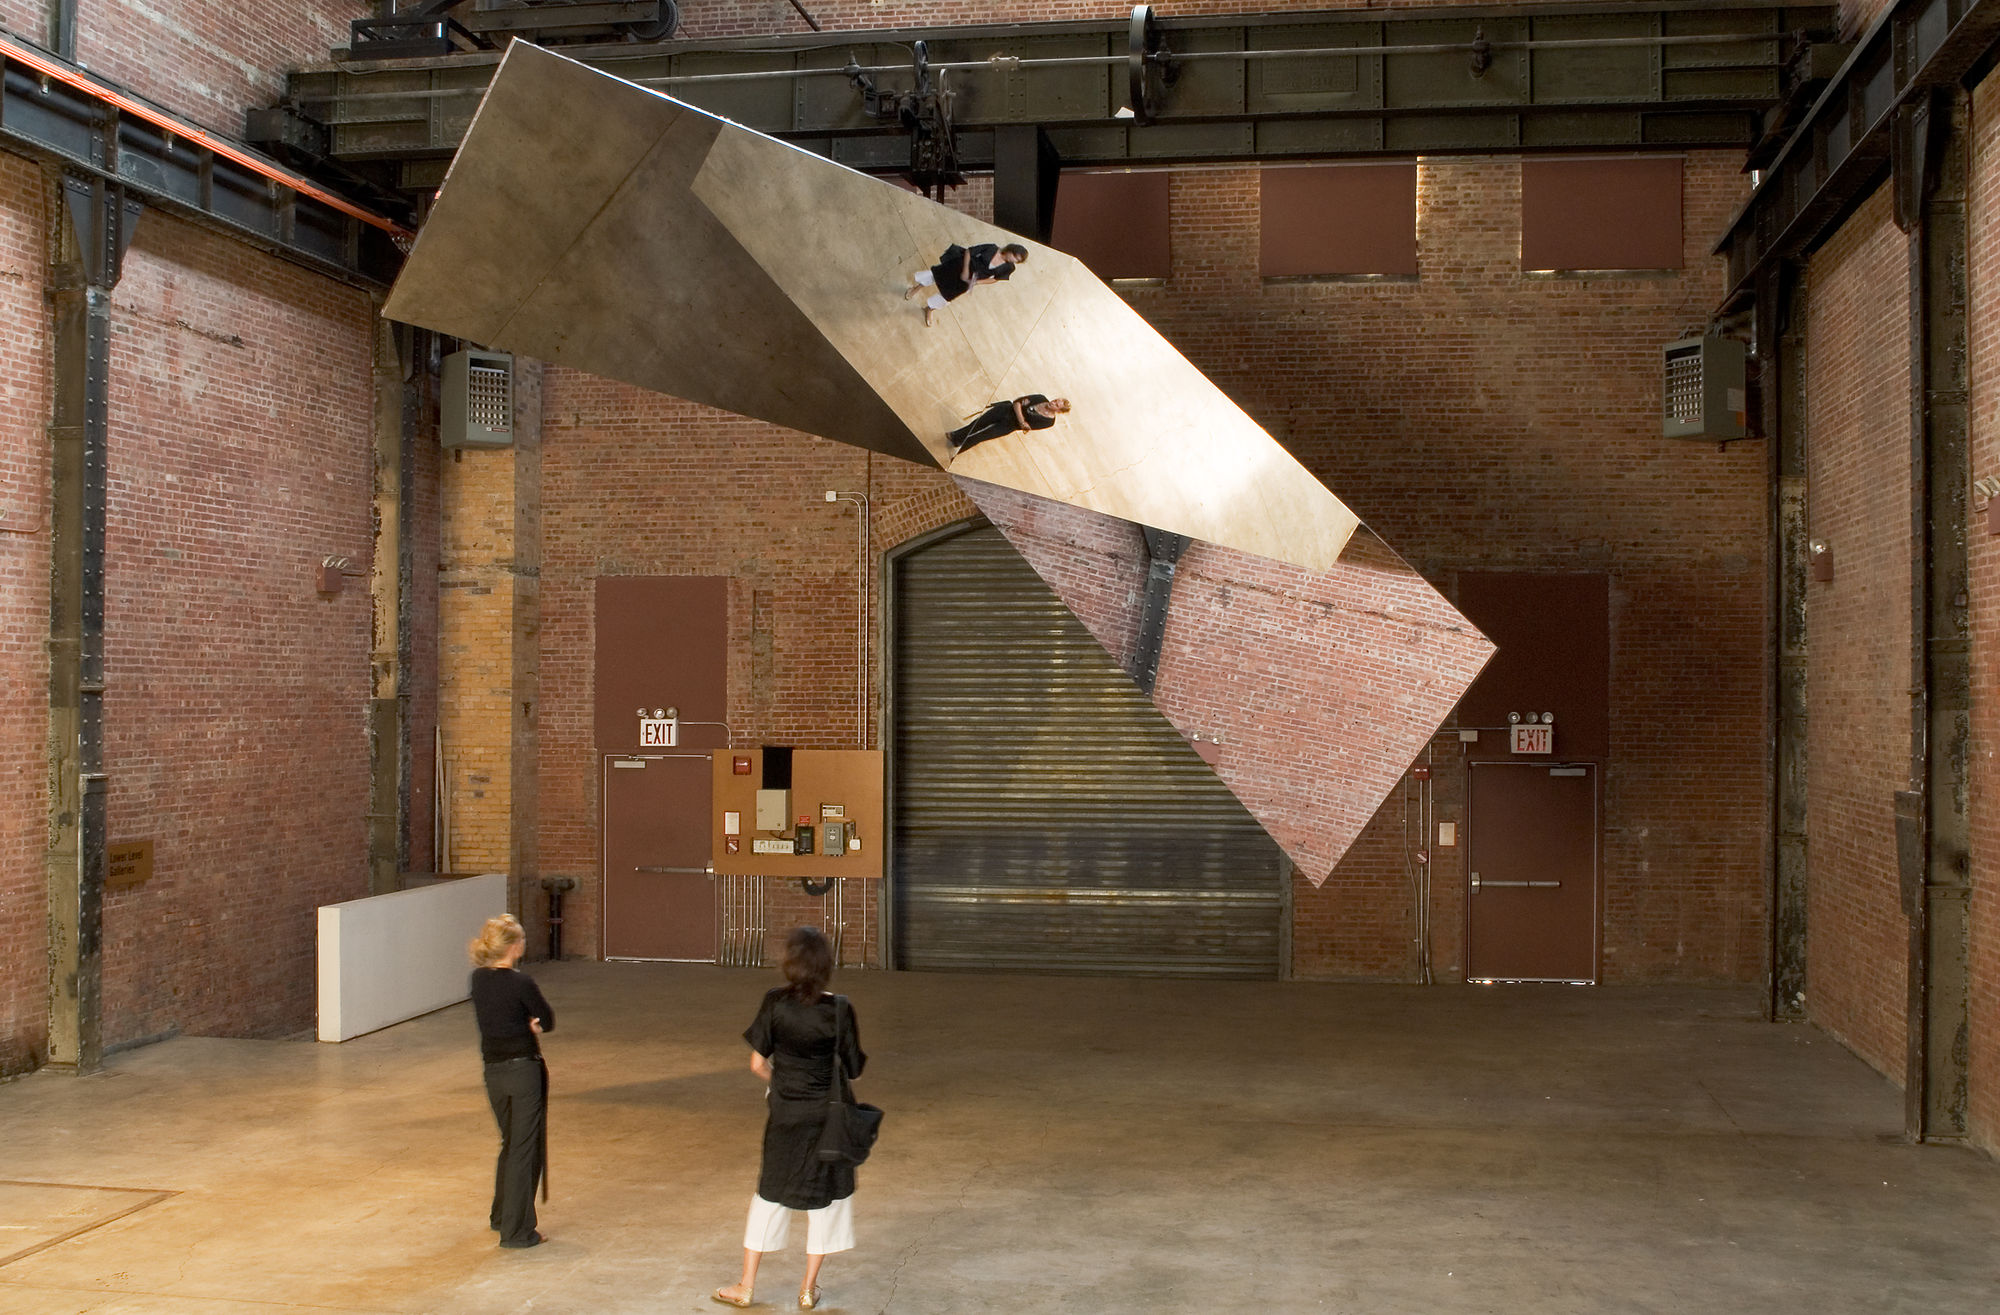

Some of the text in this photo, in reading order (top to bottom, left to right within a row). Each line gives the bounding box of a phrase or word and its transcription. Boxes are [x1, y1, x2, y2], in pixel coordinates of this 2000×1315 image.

[645, 723, 673, 744] EXIT
[1517, 729, 1548, 751] EXIT
[109, 848, 144, 863] Lower Level
